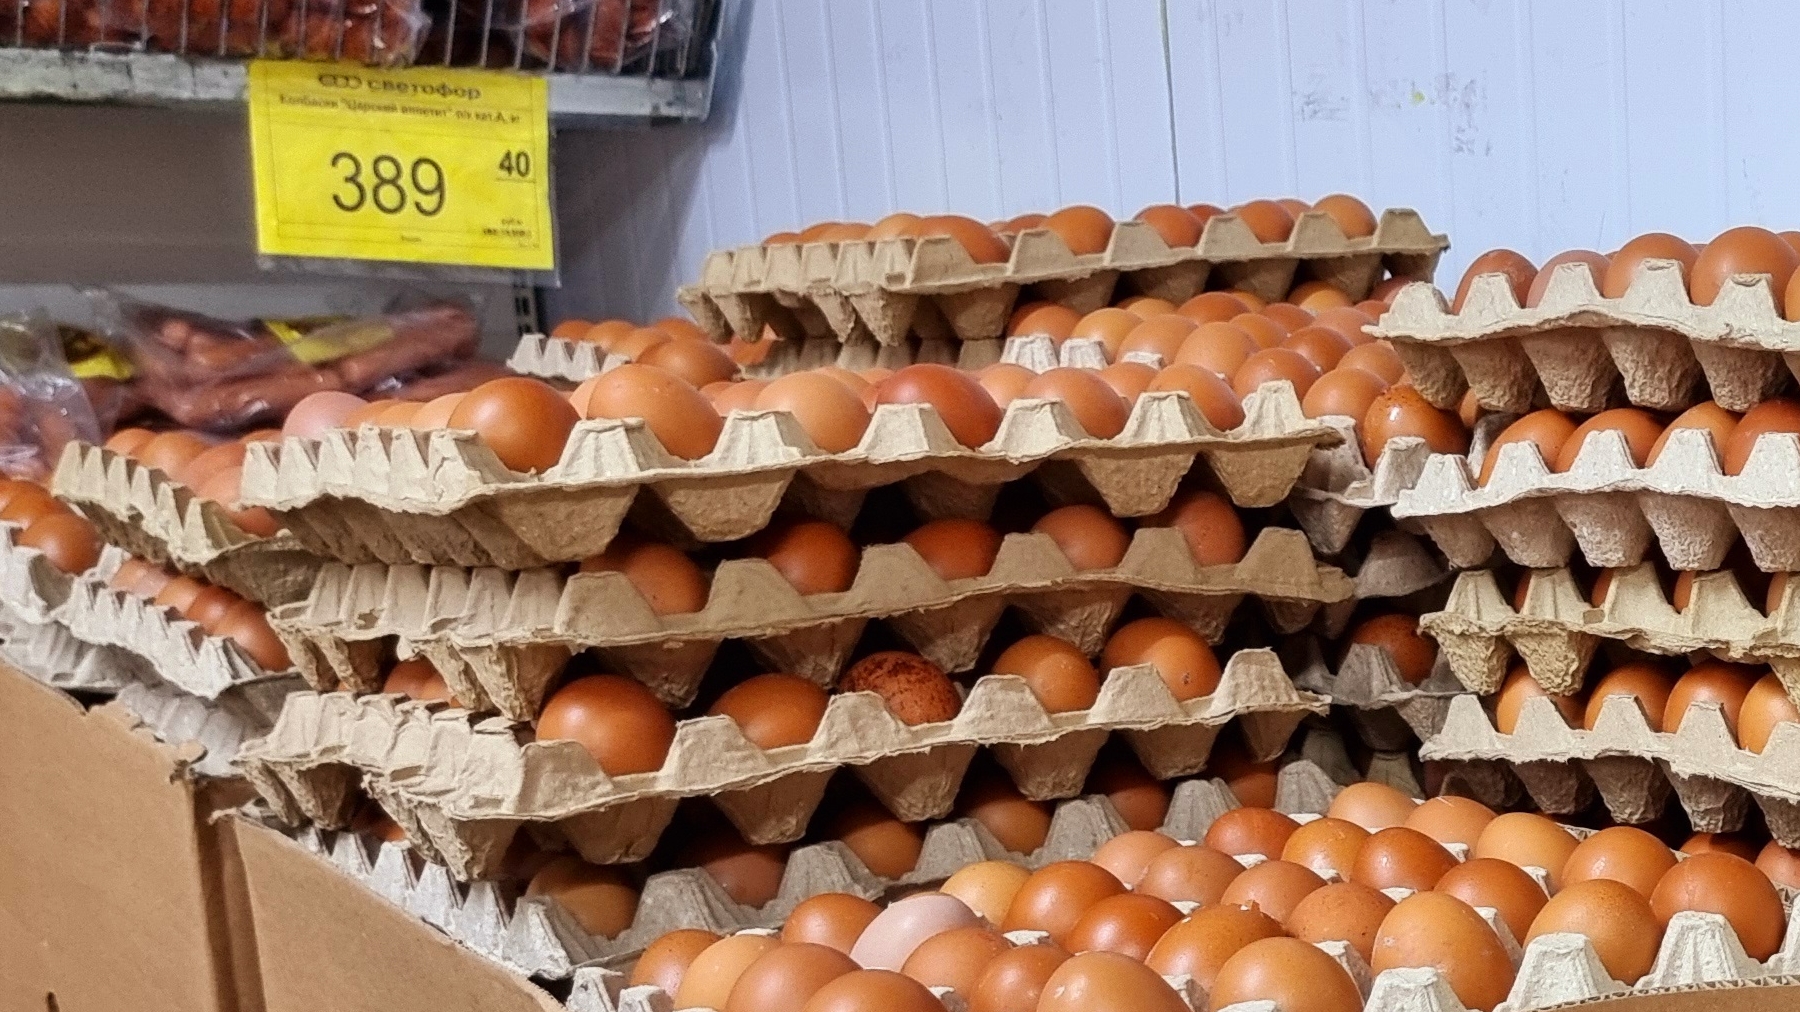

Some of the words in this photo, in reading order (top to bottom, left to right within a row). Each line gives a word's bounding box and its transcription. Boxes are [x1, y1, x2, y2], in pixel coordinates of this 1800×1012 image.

[367, 79, 481, 100] светофор
[498, 150, 531, 178] 40
[331, 151, 446, 217] 389
